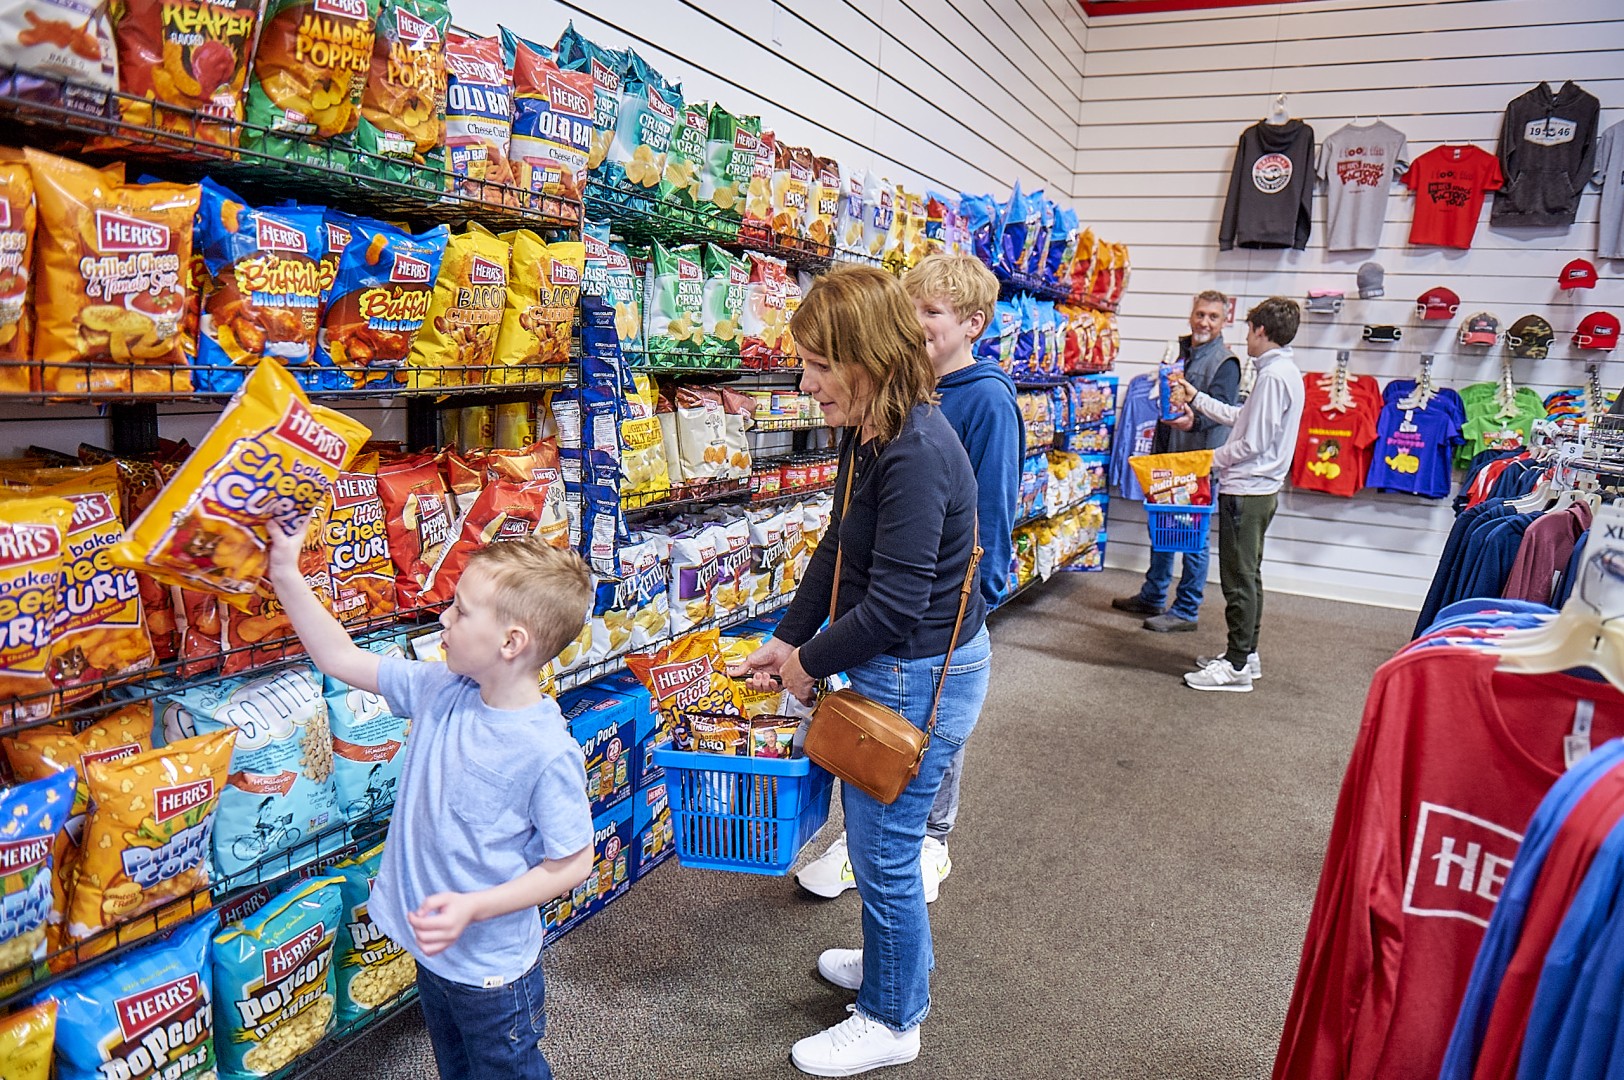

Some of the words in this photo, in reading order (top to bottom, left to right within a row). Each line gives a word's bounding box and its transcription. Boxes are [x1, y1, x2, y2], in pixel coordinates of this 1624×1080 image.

[162, 0, 255, 39] REAPER
[170, 32, 205, 47] FLAVORED
[593, 66, 618, 90] HERR'S
[449, 84, 486, 112] OLD
[551, 85, 587, 114] HERR'S
[650, 91, 674, 117] HERR'S
[467, 123, 493, 137] Cheese
[539, 111, 572, 142] OLD
[1529, 127, 1541, 136] 19
[1557, 127, 1570, 137] 46
[471, 149, 488, 161] BAY
[549, 148, 571, 163] Cheese
[731, 151, 756, 165] SOUR
[532, 170, 547, 182] OLD
[547, 170, 561, 183] BAY
[1341, 169, 1384, 185] FACTORY
[1356, 178, 1379, 187] TOUR
[105, 221, 164, 246] HERR'S
[262, 224, 302, 248] HERR'S
[585, 240, 608, 257] HERR'S
[80, 256, 136, 280] Grilled
[138, 252, 179, 272] Cheese
[397, 260, 428, 278] HERR'S
[475, 266, 503, 281] HERR'S
[555, 265, 578, 280] HERR'S
[680, 264, 700, 279] HERR'S
[102, 275, 150, 302] Tomato
[151, 271, 179, 296] Soup
[678, 281, 702, 295] SOUR
[728, 286, 746, 299] SOU
[252, 290, 284, 308] Blue
[368, 319, 397, 331] Blue
[448, 308, 503, 323] CHEDD
[289, 408, 342, 460] HERR'S
[1569, 446, 1576, 454] S
[232, 440, 323, 510] Chees
[1150, 478, 1173, 496] Multi
[1173, 472, 1197, 485] Pack
[336, 478, 378, 498] HERR'
[72, 498, 105, 526] RR'S
[325, 519, 384, 545] Chee
[421, 512, 449, 541] PEPPER
[1604, 524, 1624, 539] XL
[0, 527, 51, 560] RR'S
[333, 536, 391, 569] CURL
[332, 593, 367, 613] HEAT
[657, 660, 706, 691] HERR'S
[675, 677, 711, 709] Hot
[597, 721, 619, 746] Pack
[699, 740, 725, 751] BBQ
[609, 742, 620, 757] 28
[161, 783, 209, 812] HERR'S
[648, 785, 664, 802] HERR'S
[652, 795, 668, 820] Vari
[594, 820, 617, 847] Pack
[0, 838, 49, 868] HERR'S
[607, 841, 618, 855] 28
[225, 892, 267, 924] HERR'S
[272, 929, 319, 974] HERR'S
[126, 979, 194, 1026] HERR'S
[151, 1045, 208, 1080] ight
